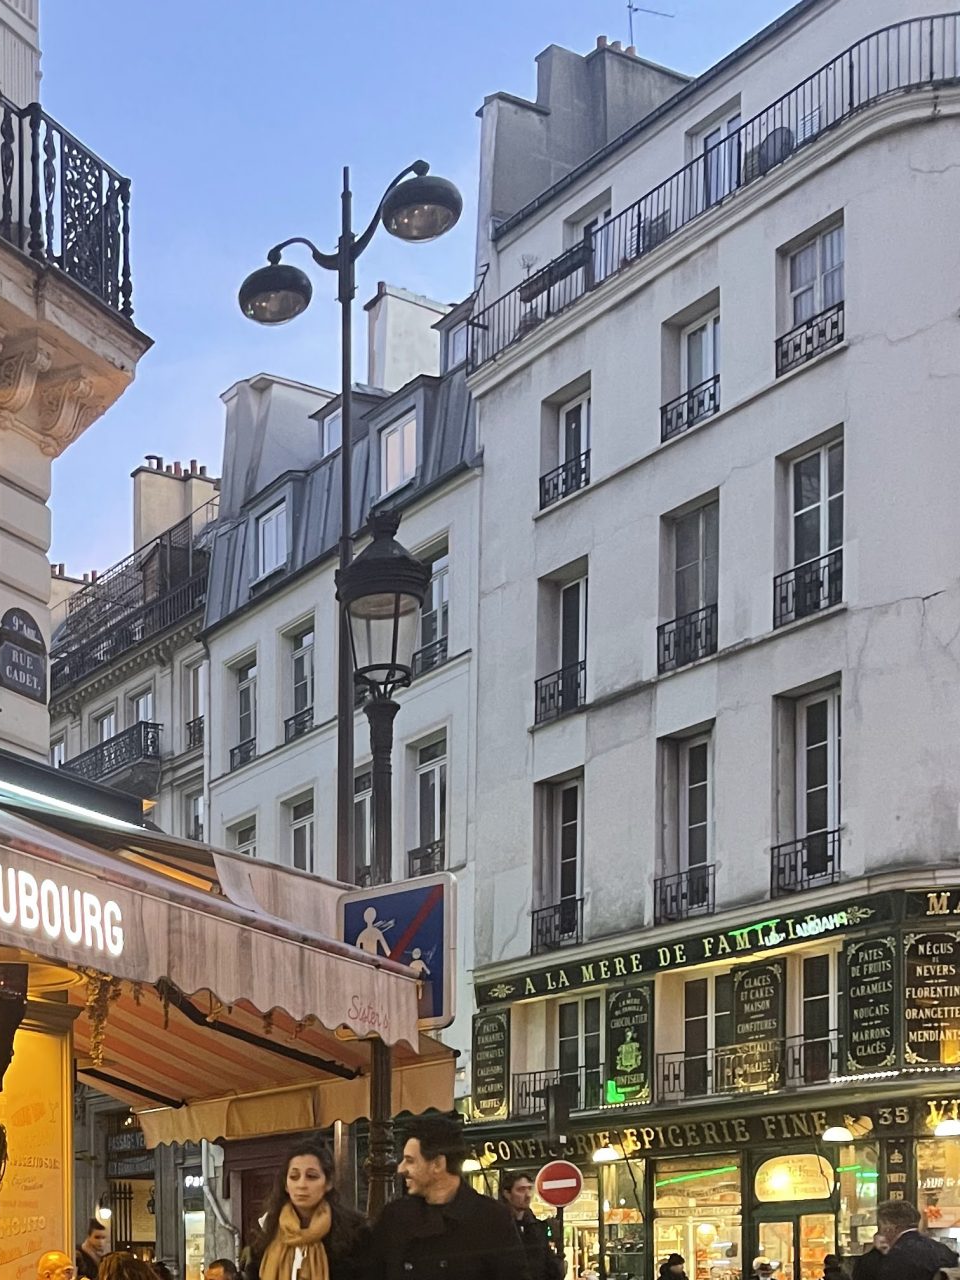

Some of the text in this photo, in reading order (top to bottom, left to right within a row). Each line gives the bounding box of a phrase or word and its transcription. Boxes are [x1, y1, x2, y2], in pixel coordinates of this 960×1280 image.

[12, 650, 33, 670] RUE
[524, 977, 537, 995] A
[545, 969, 570, 990] LA
[581, 953, 643, 983] MERE
[658, 943, 687, 967] DE
[851, 960, 892, 977] DE FRUITS
[916, 964, 956, 977] NEVERS
[850, 980, 893, 998] CARAMELS
[347, 995, 388, 1029] Sister's
[744, 1000, 770, 1013] MAISON
[853, 1004, 890, 1019] NOUGATS
[737, 1019, 777, 1034] CONFITURES
[852, 1027, 891, 1042] MARRONS
[878, 1106, 910, 1125] 35
[623, 1117, 751, 1151] EPICERIE
[761, 1110, 829, 1139] FINE
